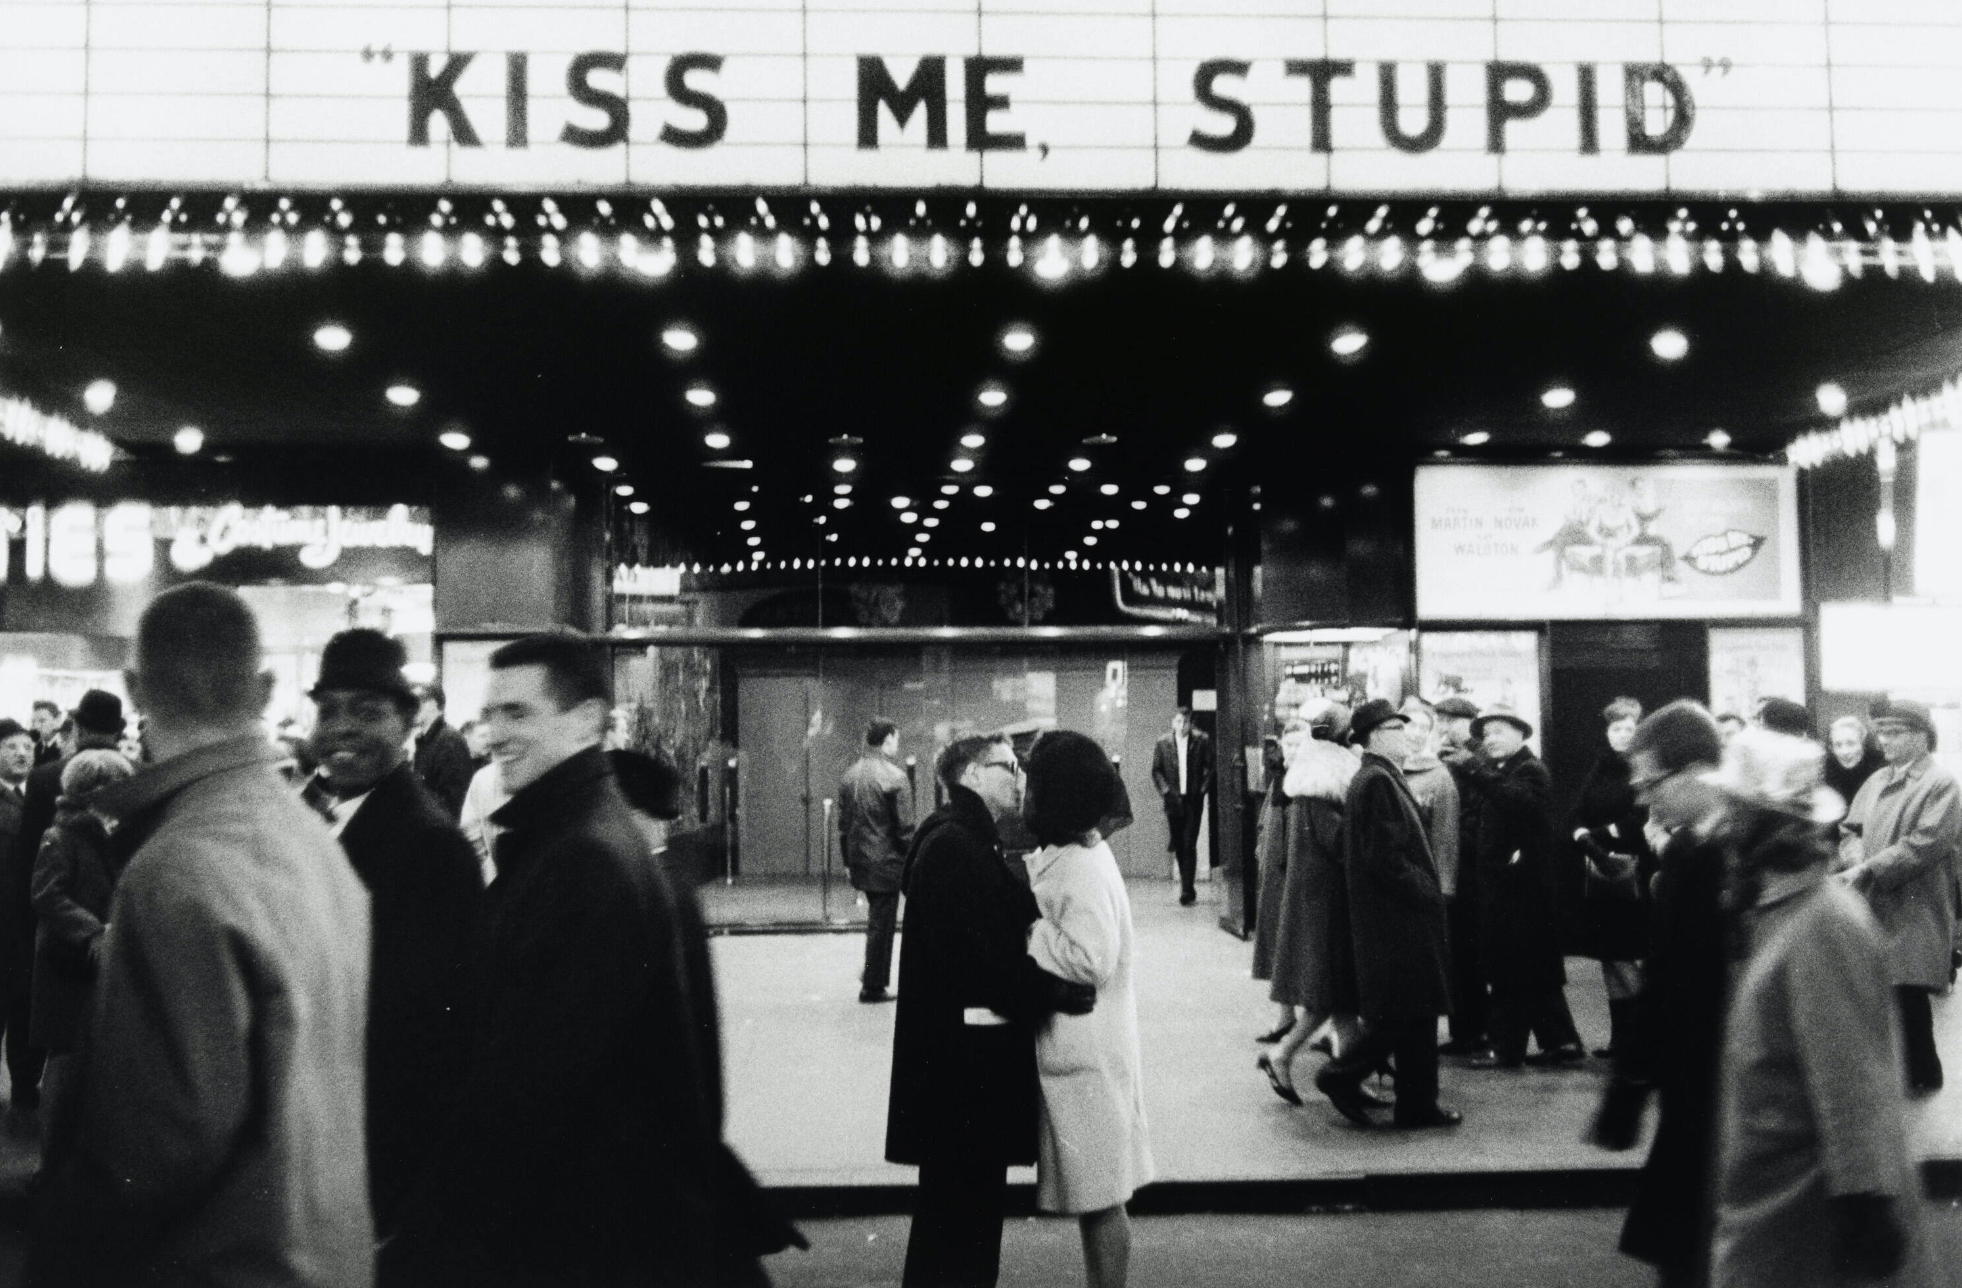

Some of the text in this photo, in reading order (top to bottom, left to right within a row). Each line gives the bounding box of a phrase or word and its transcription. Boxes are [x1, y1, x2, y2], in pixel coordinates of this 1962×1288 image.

[856, 54, 1050, 160] ME,
[299, 504, 434, 569] Jewelry
[1430, 516, 1539, 530] MARTIN NOVAK
